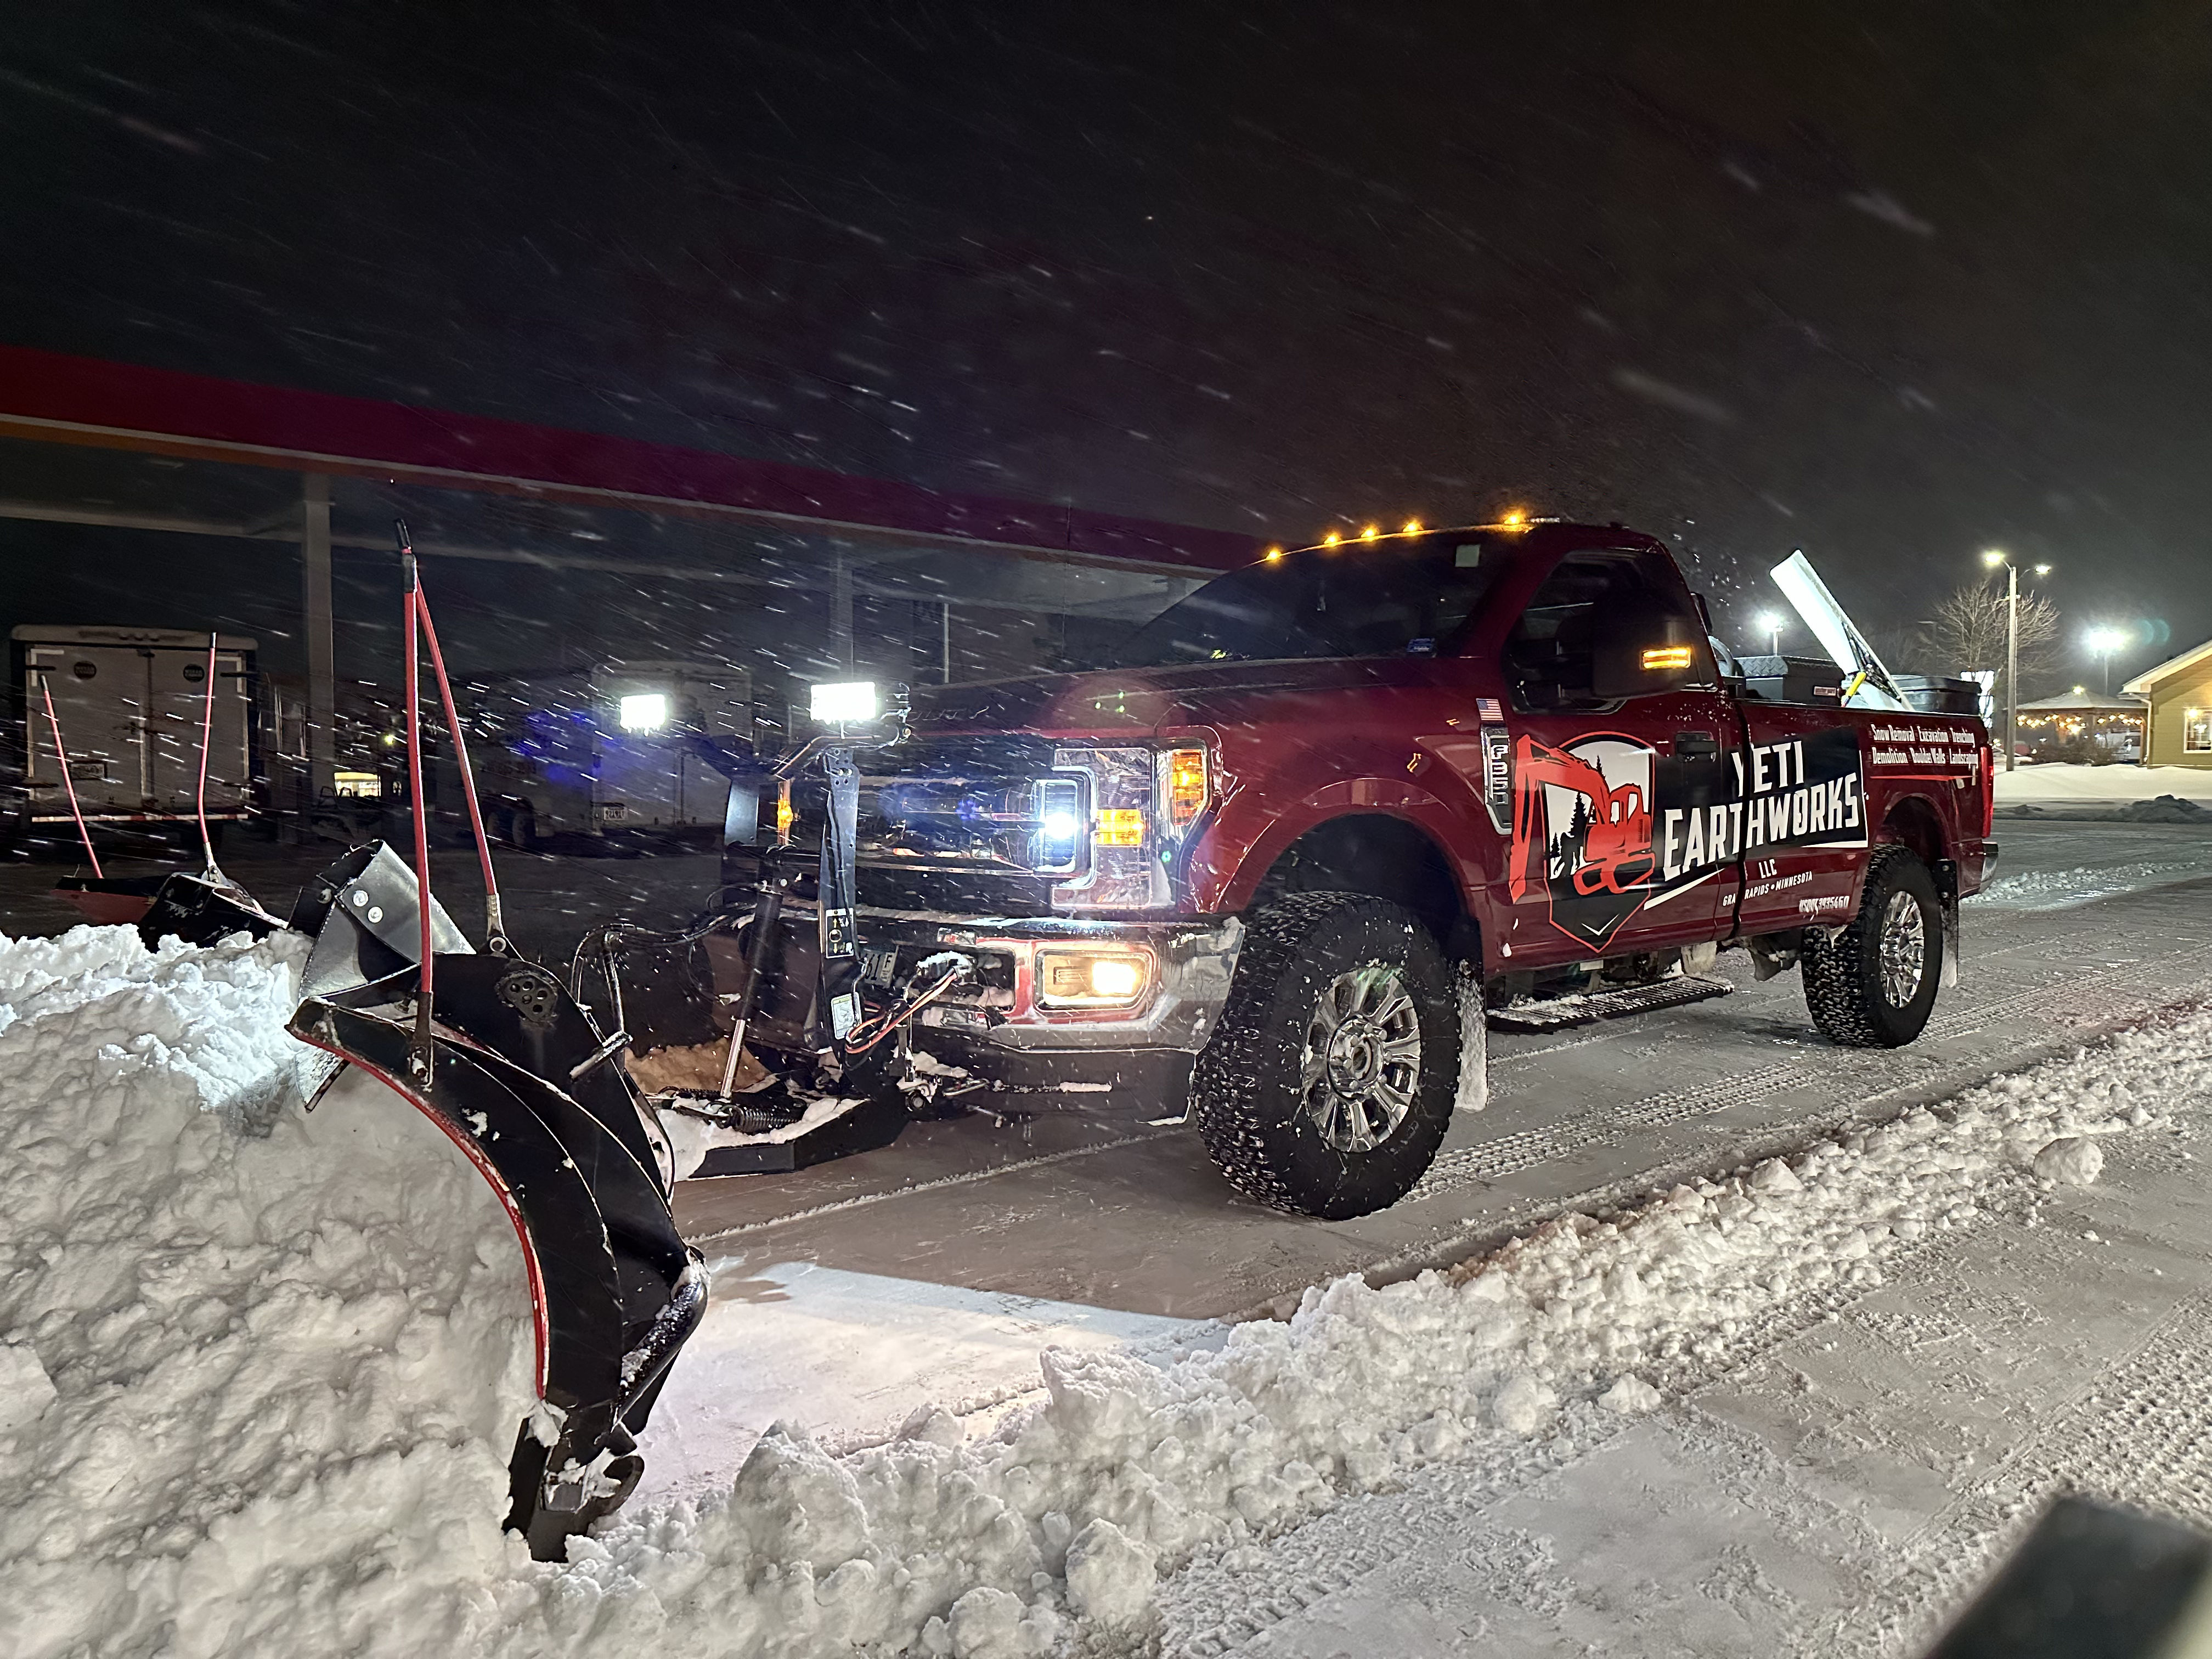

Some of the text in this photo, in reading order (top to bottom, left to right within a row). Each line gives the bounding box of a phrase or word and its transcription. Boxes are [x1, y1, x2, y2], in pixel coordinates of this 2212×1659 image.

[1870, 724, 1975, 748] Snow Removal Excavation Trenching
[1731, 741, 1804, 797] YETI
[1871, 747, 1909, 764] Demolition
[1930, 748, 1946, 764] Walls
[1949, 748, 1979, 769] Landscaping
[1663, 772, 1859, 882] EARTHWORKS
[1758, 859, 1777, 879] LLC
[1723, 871, 1813, 906] GRA RAPIDS MINNESOTA
